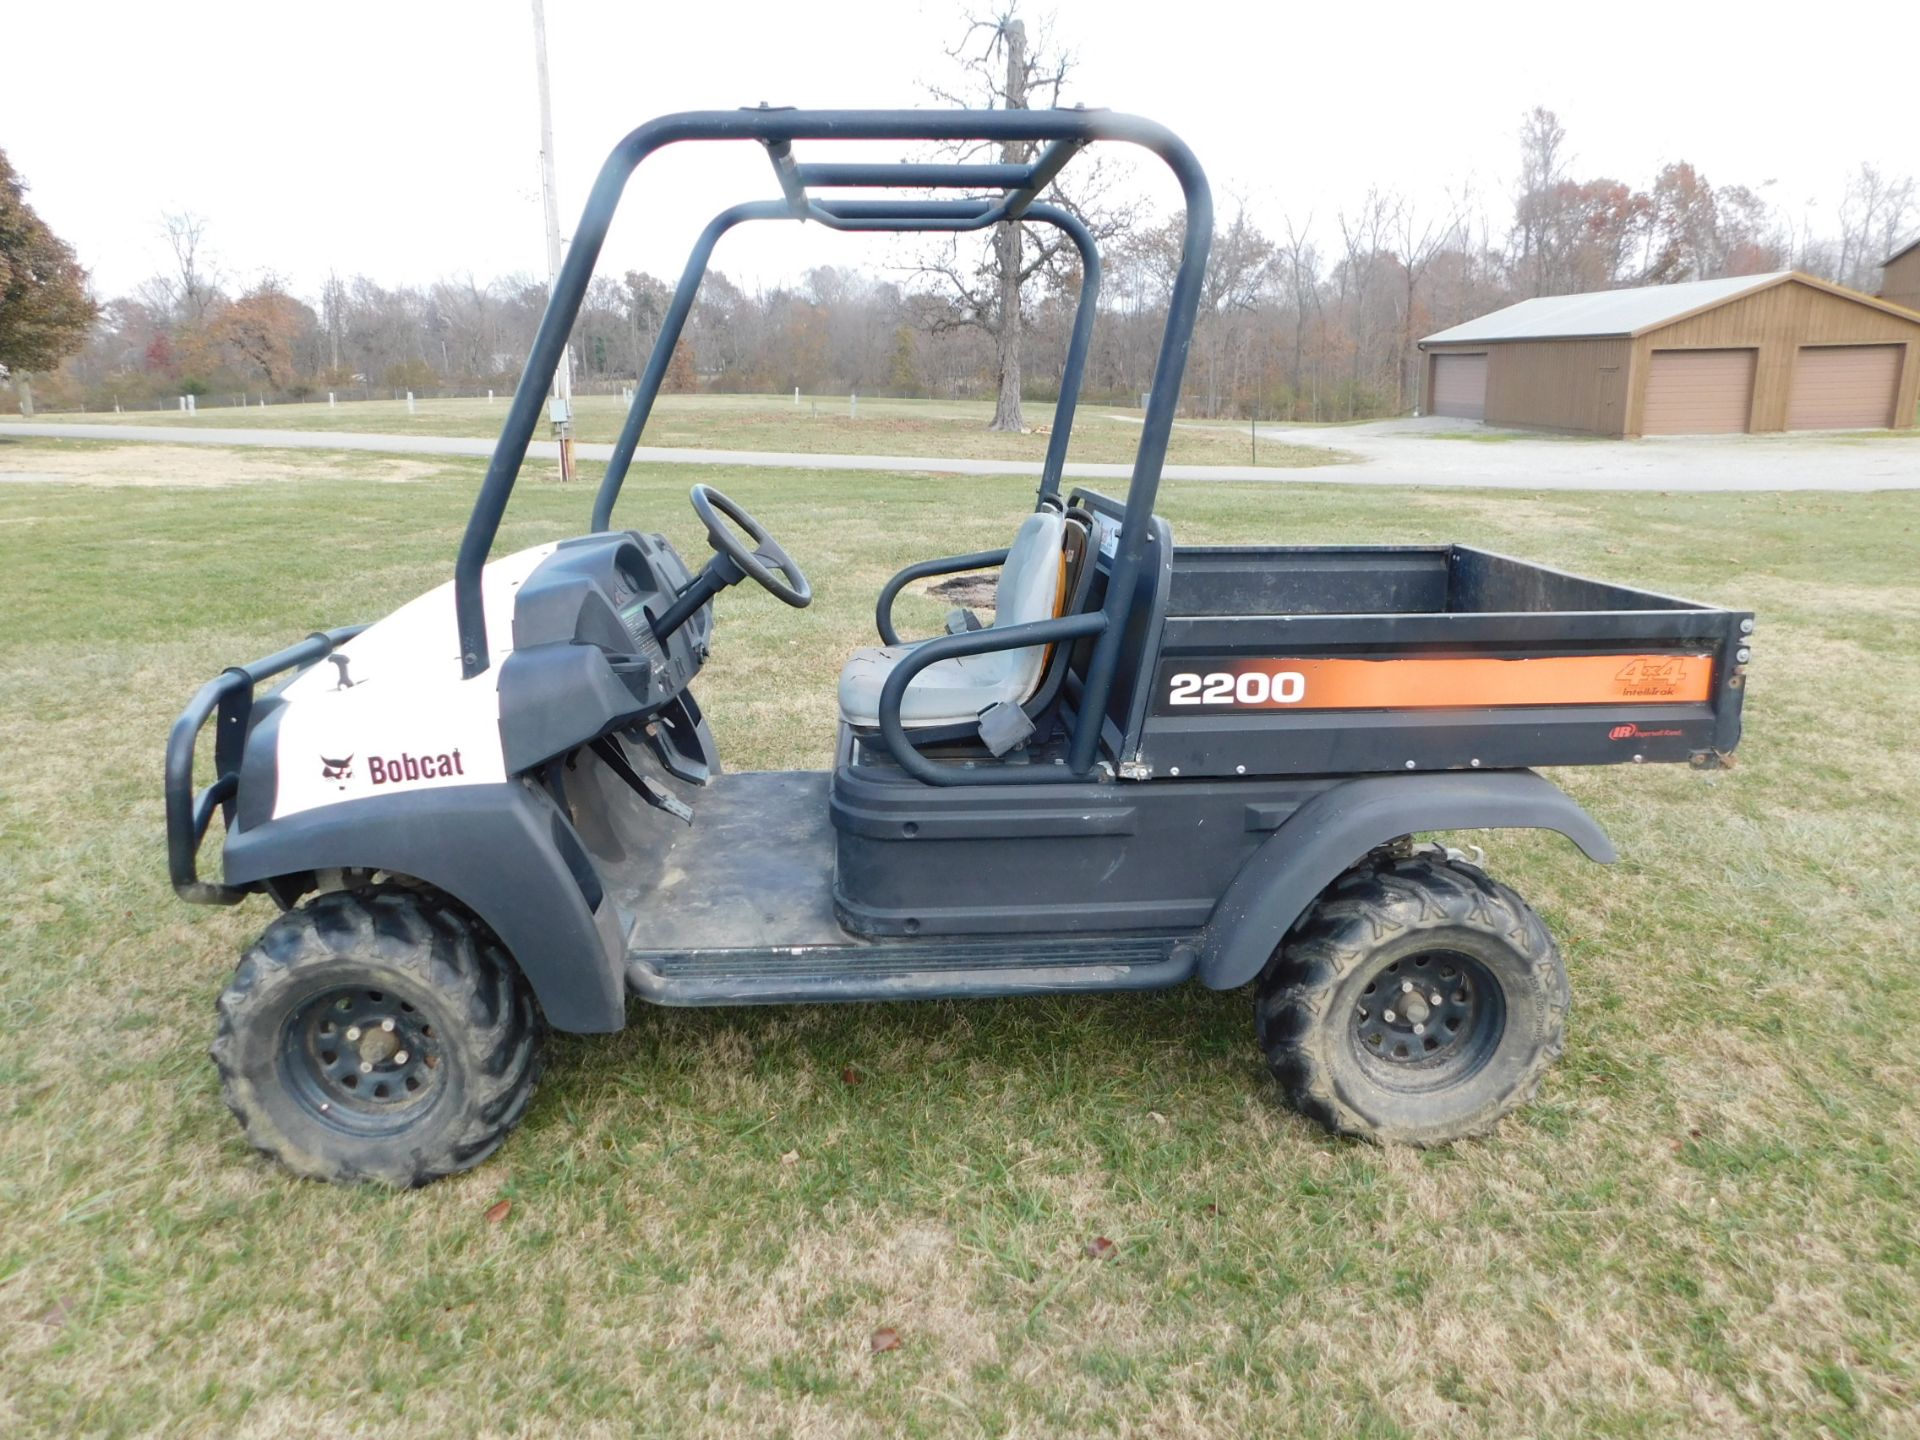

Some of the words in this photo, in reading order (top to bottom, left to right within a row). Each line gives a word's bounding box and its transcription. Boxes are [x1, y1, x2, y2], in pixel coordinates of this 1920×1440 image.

[1169, 671, 1305, 705] 2200
[1615, 658, 1687, 687] 4x4
[1612, 726, 1632, 738] IR
[368, 749, 464, 785] Bobcat
